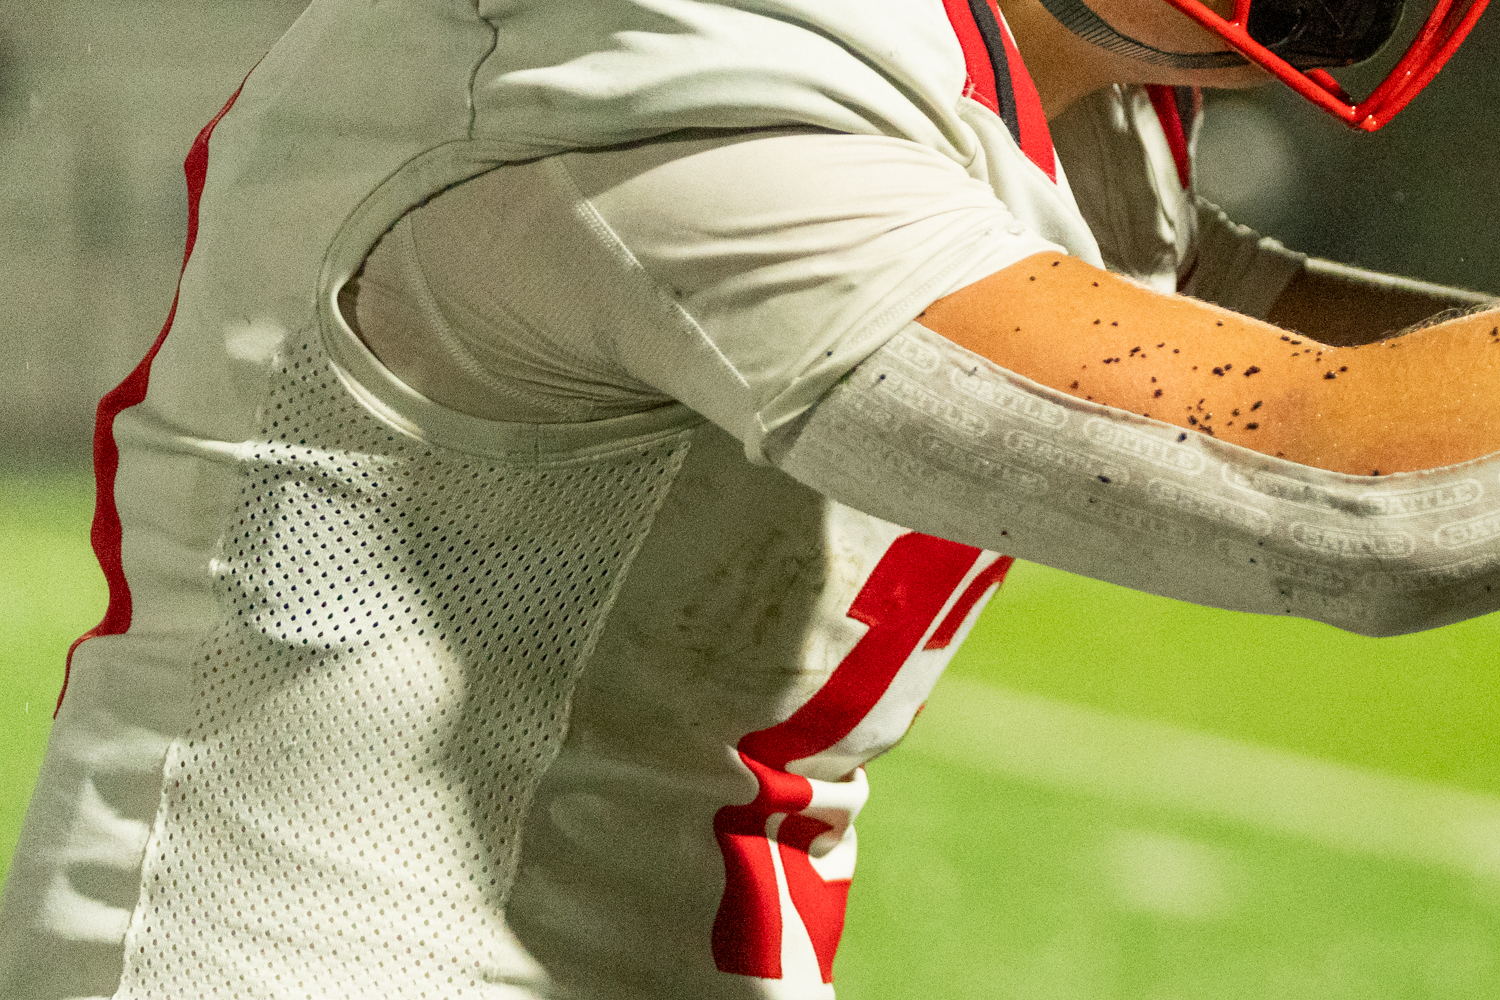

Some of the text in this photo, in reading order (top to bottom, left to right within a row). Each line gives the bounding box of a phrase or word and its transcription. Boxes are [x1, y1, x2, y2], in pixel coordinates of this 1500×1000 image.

[885, 372, 980, 432] BATTLE
[962, 376, 1061, 425] BATTLE
[1097, 423, 1199, 469] BATTLE
